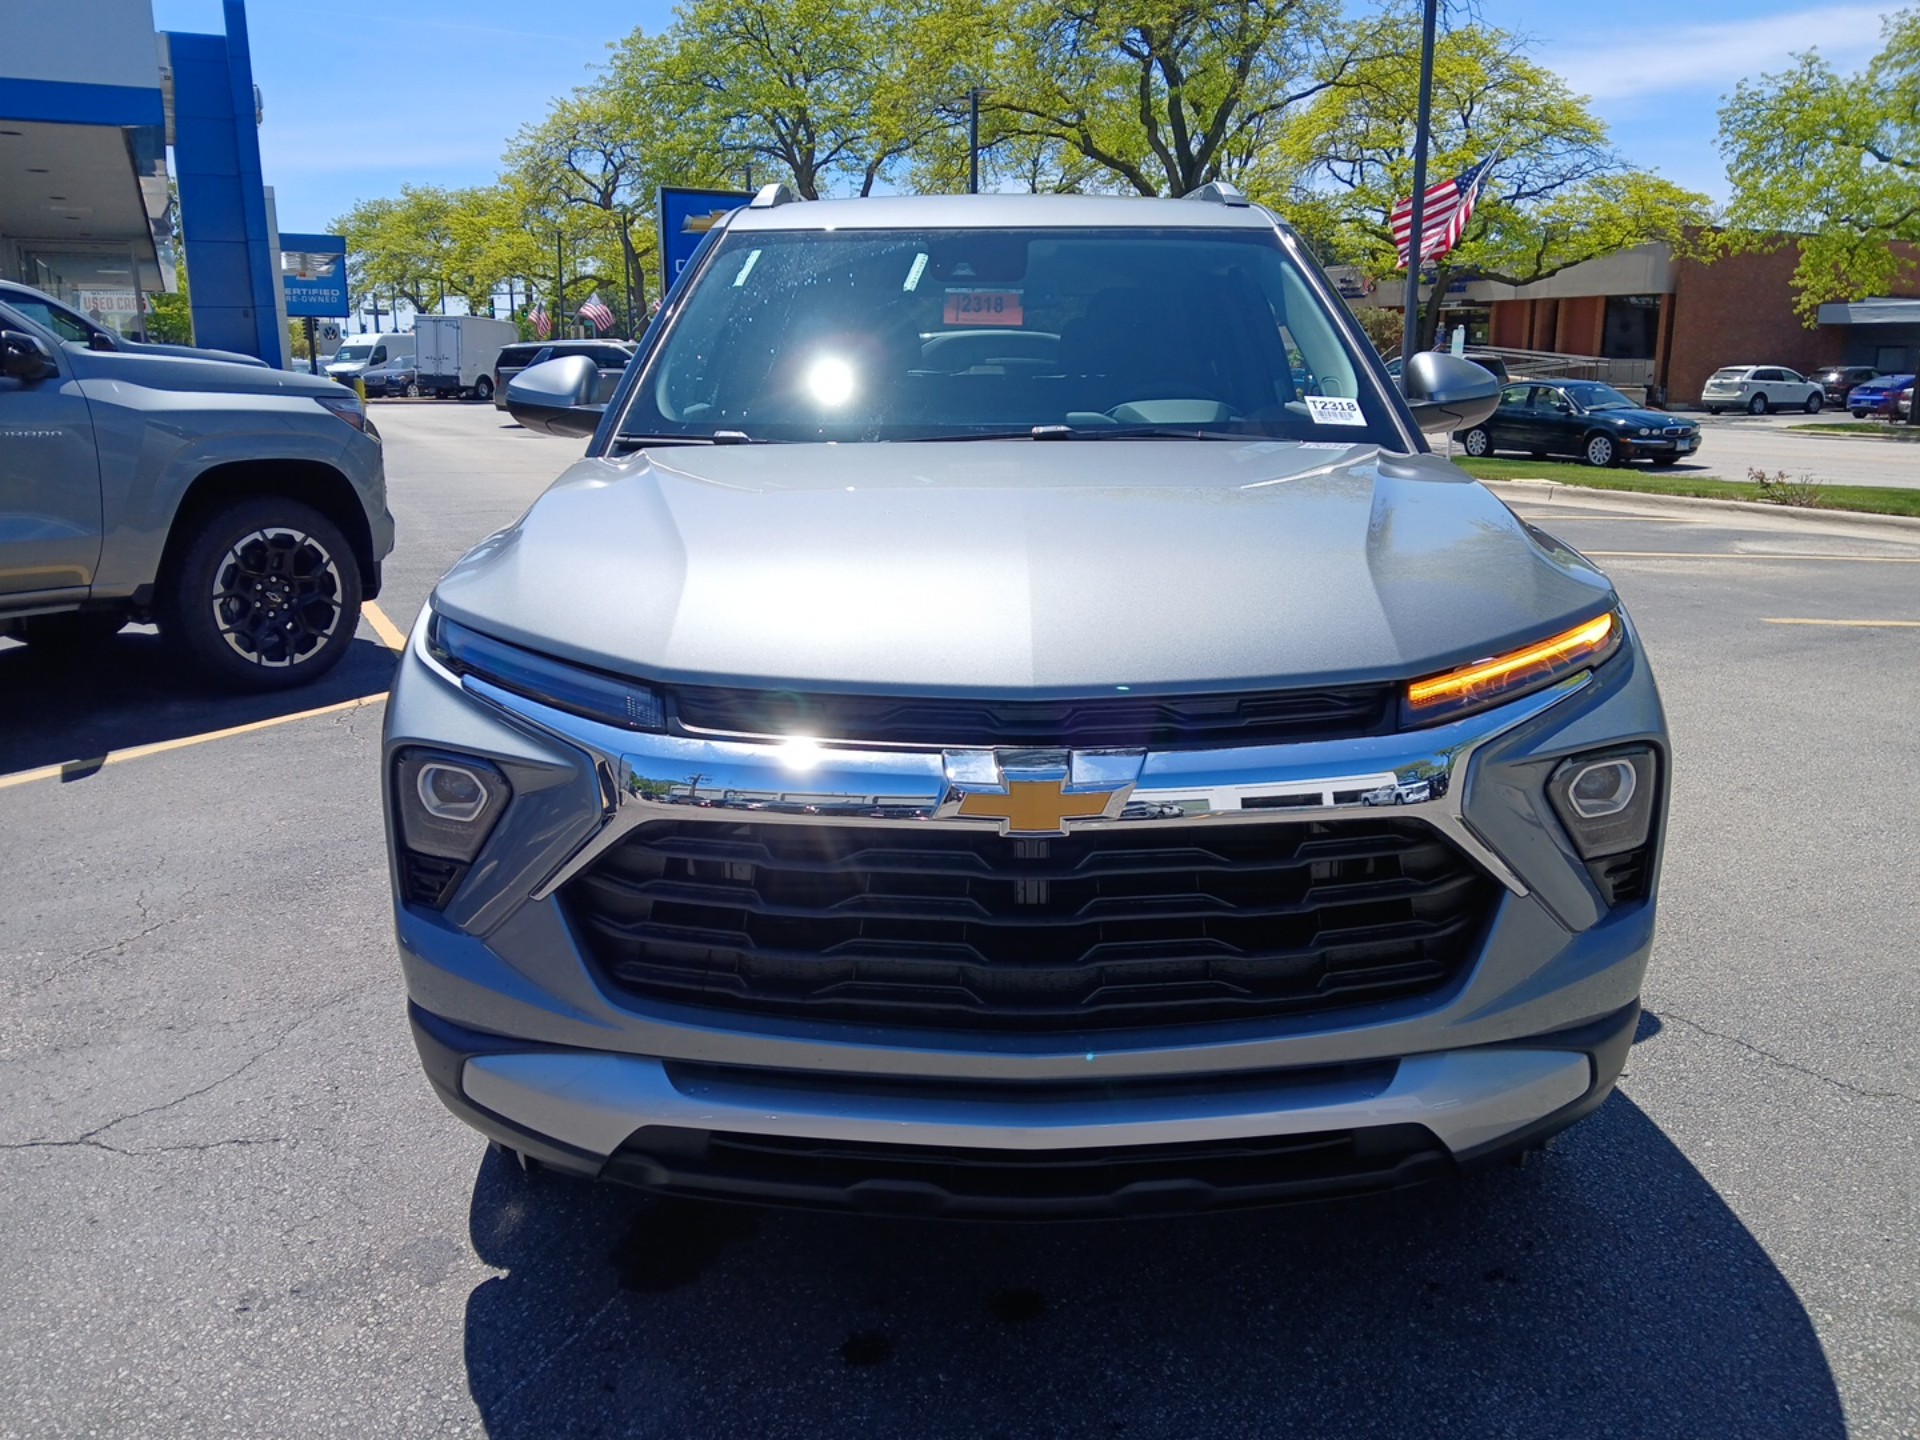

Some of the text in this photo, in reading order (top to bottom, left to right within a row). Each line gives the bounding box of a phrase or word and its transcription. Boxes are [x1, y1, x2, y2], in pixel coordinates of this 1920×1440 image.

[285, 288, 340, 296] ERTIFIED
[83, 296, 114, 310] USED
[286, 295, 338, 303] RE-OWNED
[961, 295, 1004, 313] 2318
[1309, 400, 1356, 411] T2318
